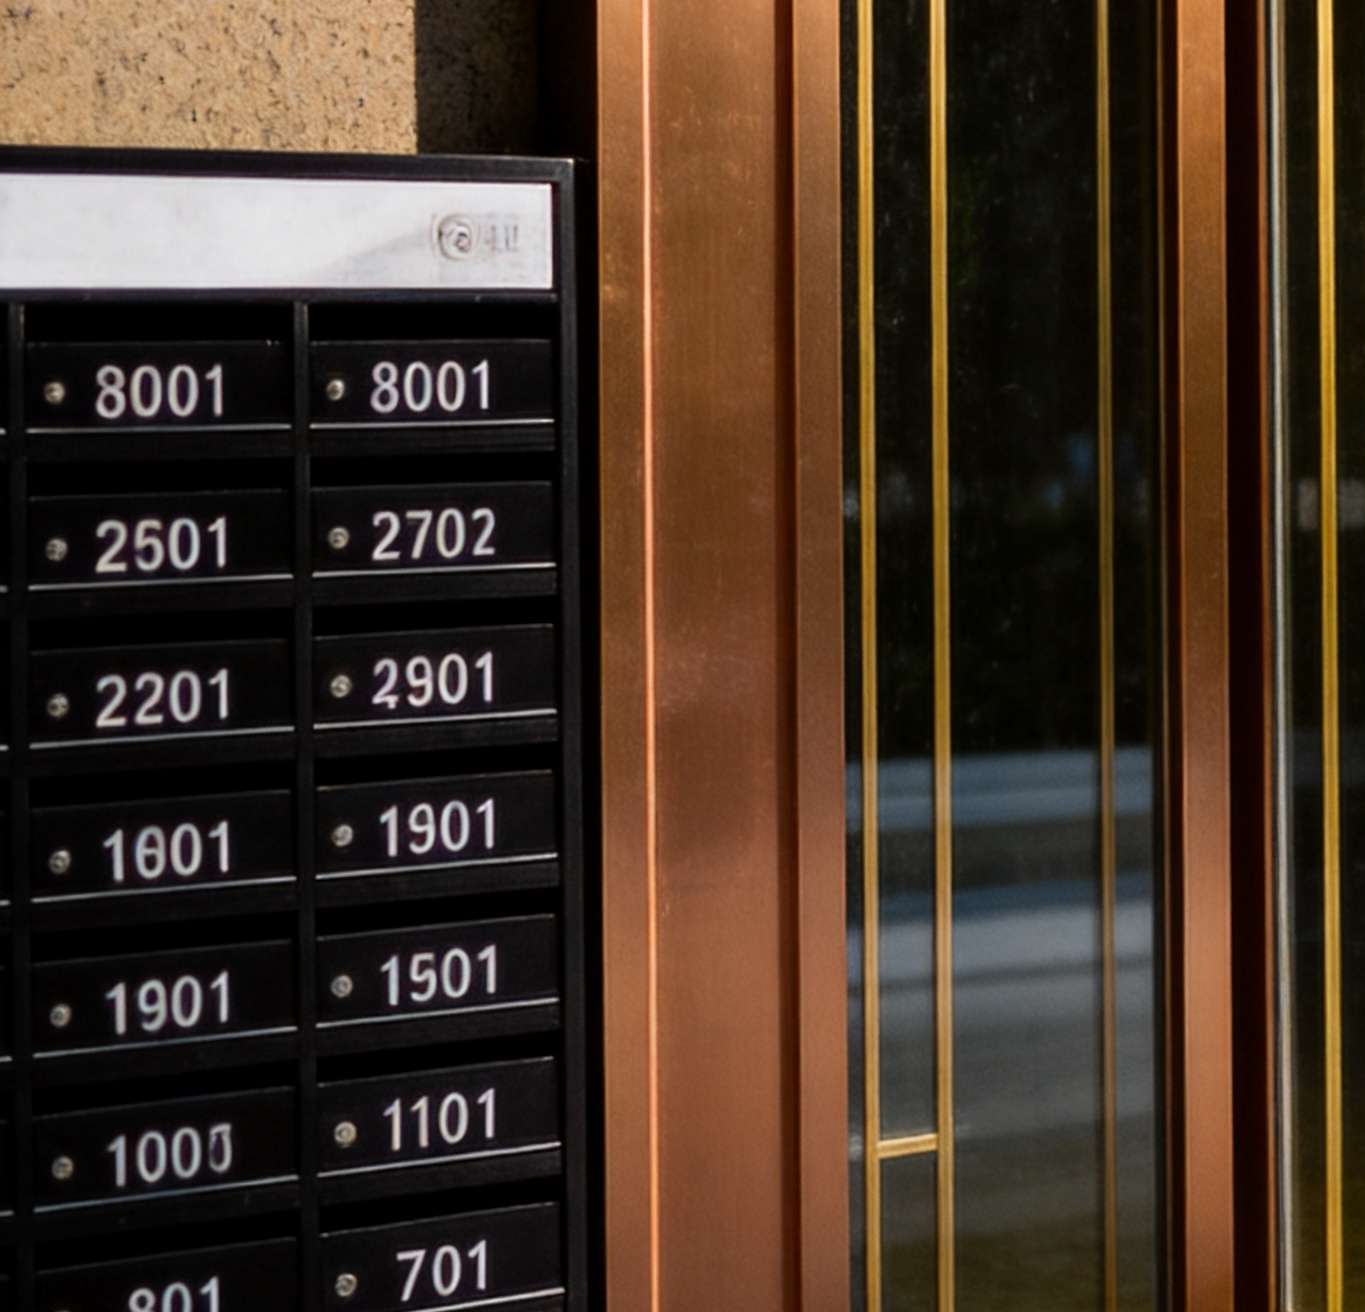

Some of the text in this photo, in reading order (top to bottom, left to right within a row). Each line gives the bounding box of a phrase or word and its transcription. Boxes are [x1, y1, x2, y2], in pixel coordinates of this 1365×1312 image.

[95, 364, 223, 419] 8001
[370, 359, 489, 413] 8001
[95, 517, 226, 573] 2501
[372, 507, 495, 561] 2702
[95, 668, 228, 728] 2201
[372, 651, 493, 707] 2901
[380, 798, 494, 857] 1901
[107, 971, 229, 1035] 1901
[381, 944, 496, 1006] 1501
[384, 1088, 495, 1151] 1101
[396, 1239, 487, 1302] 701
